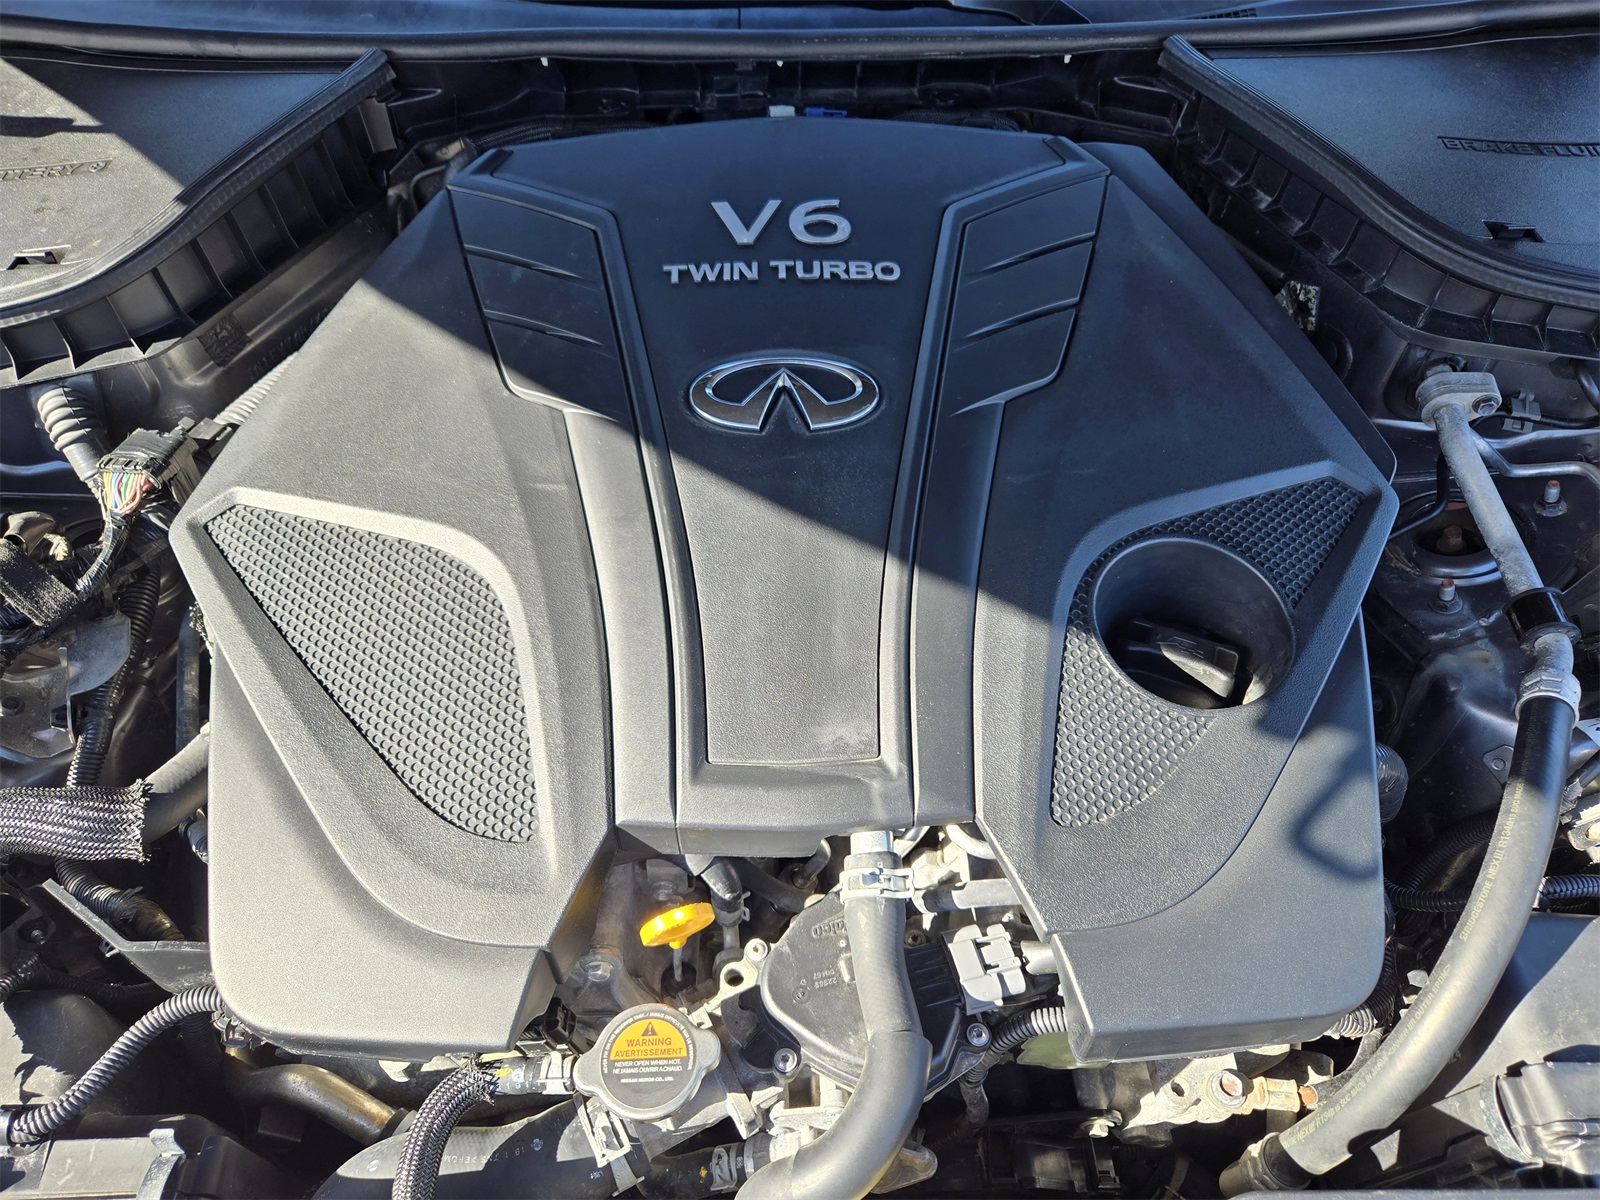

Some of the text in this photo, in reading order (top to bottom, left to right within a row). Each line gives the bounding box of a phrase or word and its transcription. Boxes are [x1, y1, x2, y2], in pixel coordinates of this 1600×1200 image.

[1441, 138, 1534, 156] BRAKE
[710, 199, 852, 246] V6
[662, 260, 901, 284] TWIN TURBO
[1459, 881, 1493, 942] BRIDGESTONE
[1511, 799, 1520, 812] SUC
[614, 1047, 683, 1058] AVERTISSEMENT
[626, 1037, 672, 1047] WARNING
[1340, 1095, 1351, 1107] SUC
[1350, 1081, 1366, 1097] MADE
[1415, 993, 1435, 1019] OUTER
